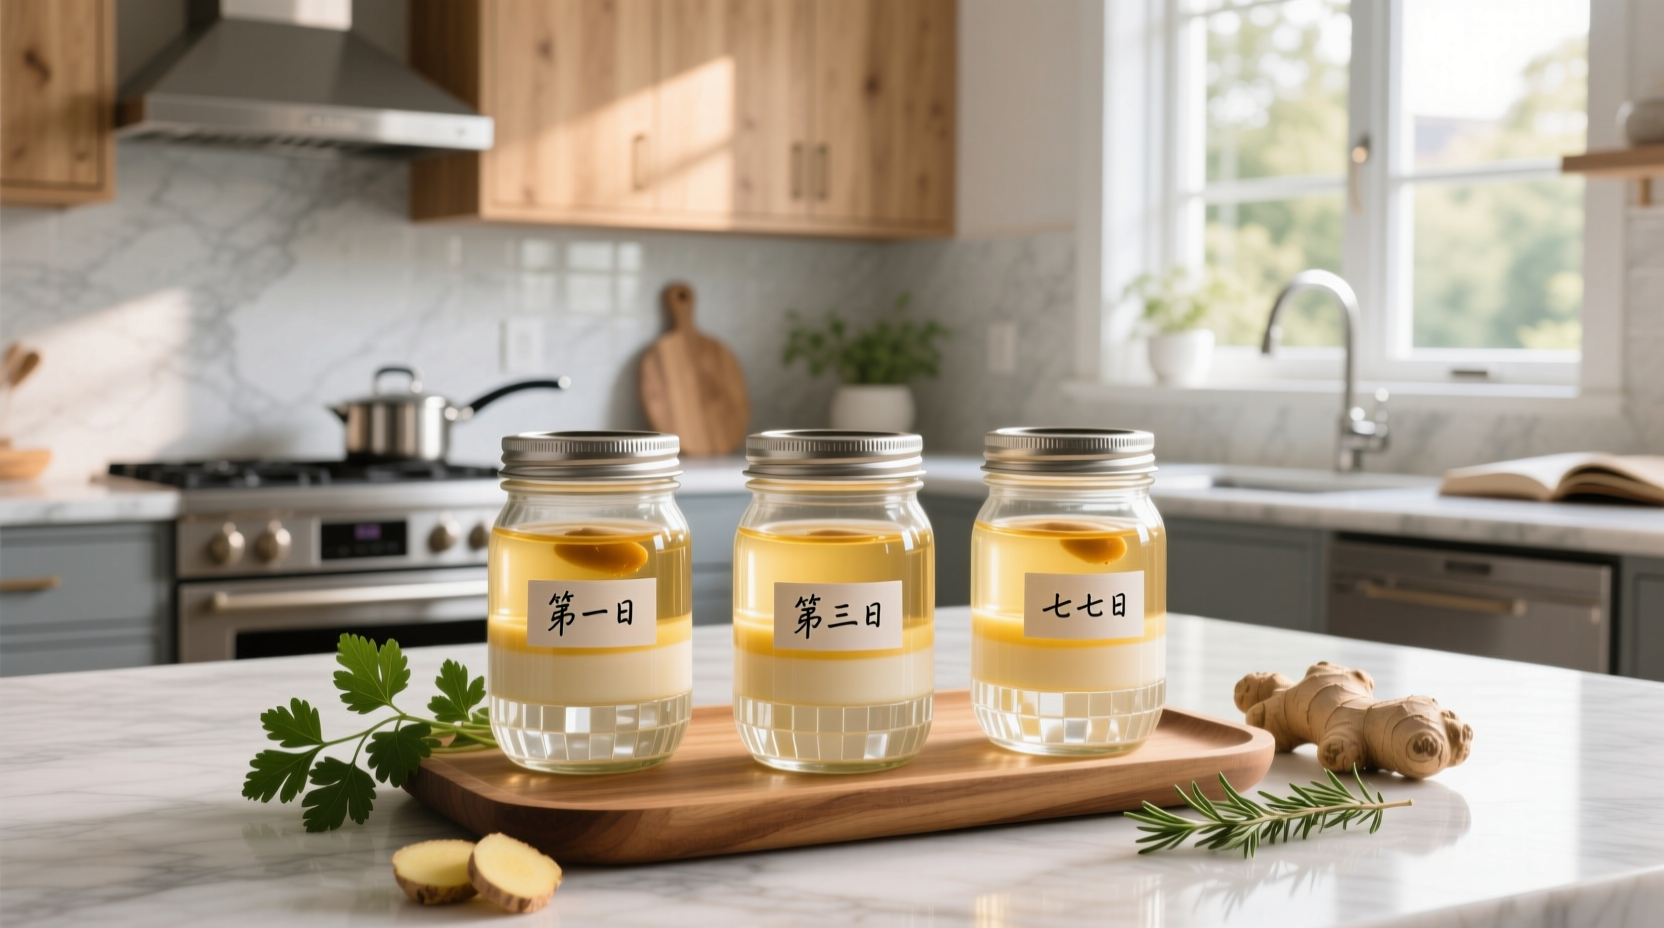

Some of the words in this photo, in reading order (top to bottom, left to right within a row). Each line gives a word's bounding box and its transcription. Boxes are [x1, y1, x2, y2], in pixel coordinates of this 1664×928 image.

[547, 590, 633, 637] 第一日
[793, 593, 881, 640] 第三日
[1042, 592, 1126, 619] 七七日
